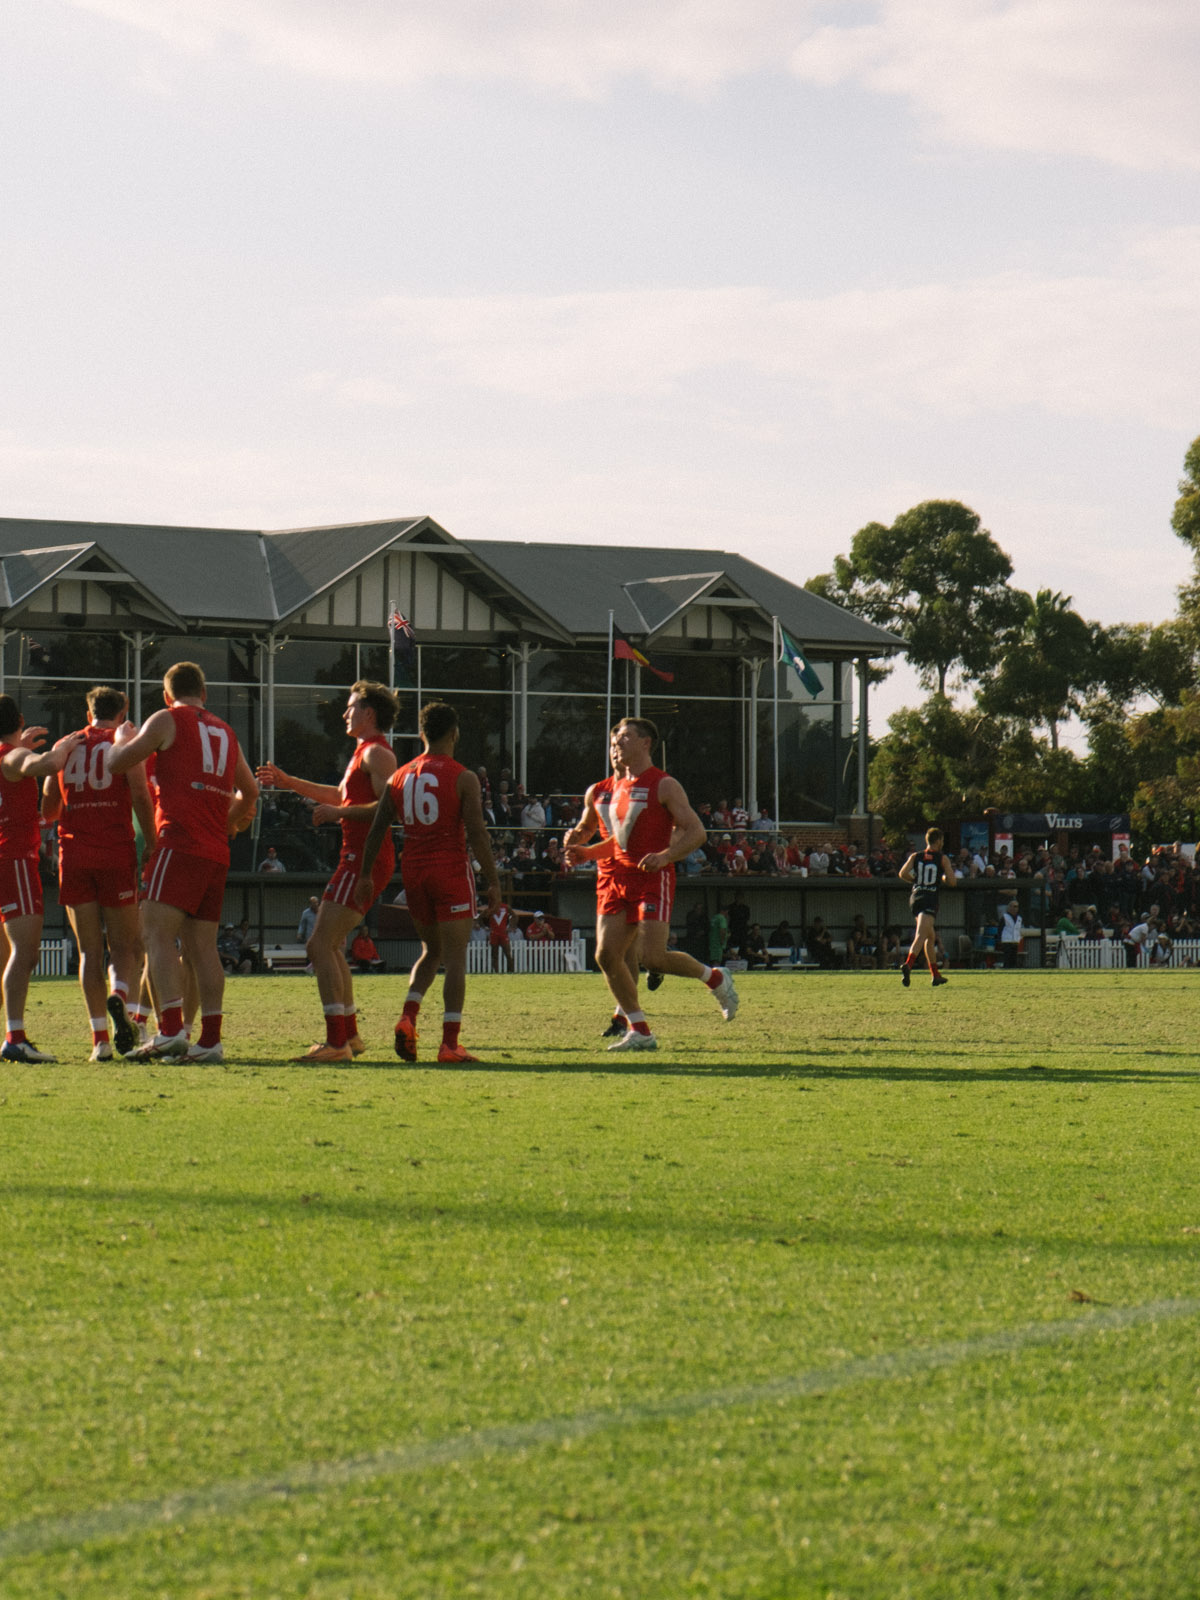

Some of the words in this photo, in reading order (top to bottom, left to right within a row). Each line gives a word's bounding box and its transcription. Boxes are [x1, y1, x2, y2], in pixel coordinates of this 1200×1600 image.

[63, 741, 113, 792] 40
[197, 721, 229, 776] 17
[403, 772, 439, 825] 16
[917, 861, 938, 886] 10
